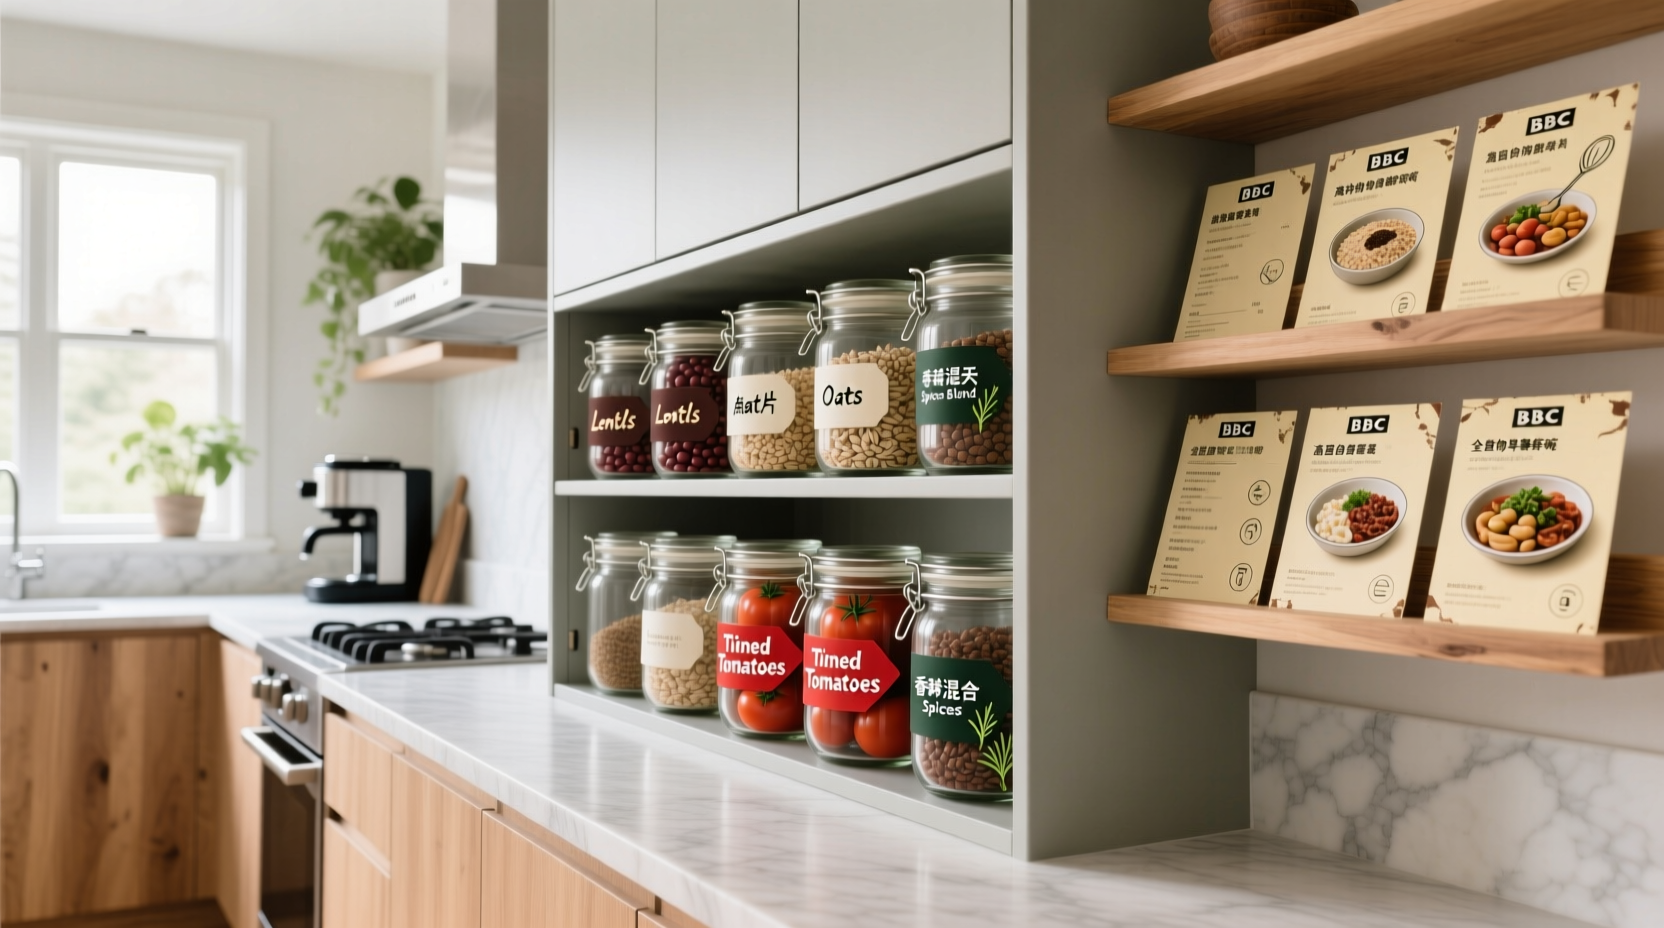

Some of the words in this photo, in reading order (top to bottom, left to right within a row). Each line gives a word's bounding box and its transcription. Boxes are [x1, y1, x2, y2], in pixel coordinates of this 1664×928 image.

[1529, 111, 1571, 133] BBC
[1370, 150, 1405, 169] BBC
[822, 385, 863, 407] Oats
[1350, 417, 1386, 433] BBC
[1516, 408, 1560, 426] BBC
[1221, 423, 1252, 437] BBC
[805, 667, 880, 693] Tomatoes
